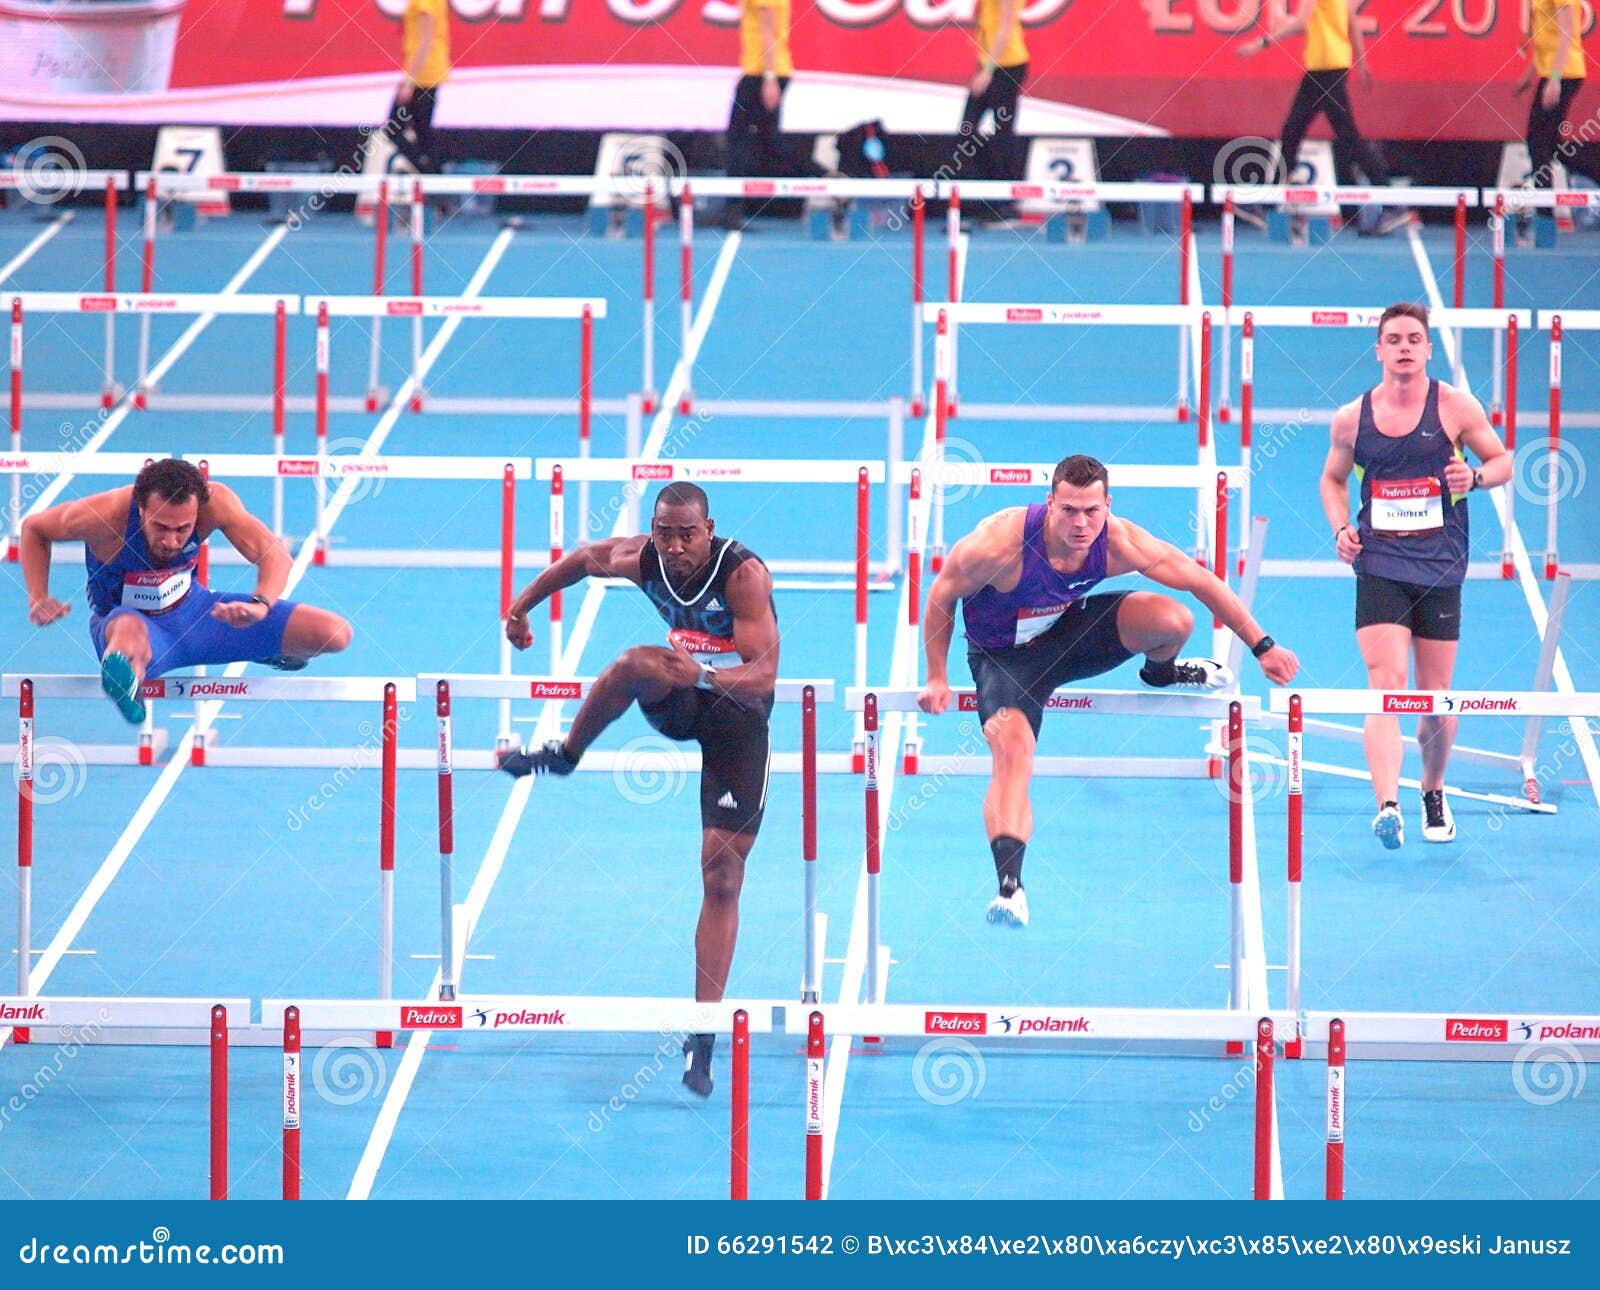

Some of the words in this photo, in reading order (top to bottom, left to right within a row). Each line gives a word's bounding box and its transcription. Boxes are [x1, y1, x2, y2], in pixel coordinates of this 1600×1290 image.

[993, 470, 1029, 482] Pedro's
[1413, 487, 1430, 497] Cup
[134, 578, 184, 601] DOUVALIDIS
[190, 682, 249, 697] polanik
[535, 684, 577, 697] Pedro's
[1044, 695, 1093, 709] olanik
[1387, 697, 1429, 711] Pedro's
[1459, 697, 1518, 712] polanik
[406, 1009, 457, 1024] Pedro's
[493, 1009, 567, 1028] polanik
[930, 1015, 981, 1031] Pedro's
[1018, 1016, 1091, 1035] polanik
[1451, 1022, 1502, 1038] Pedro's
[286, 1073, 297, 1115] polanik
[810, 1079, 820, 1121] polanik
[1331, 1086, 1341, 1129] polanik
